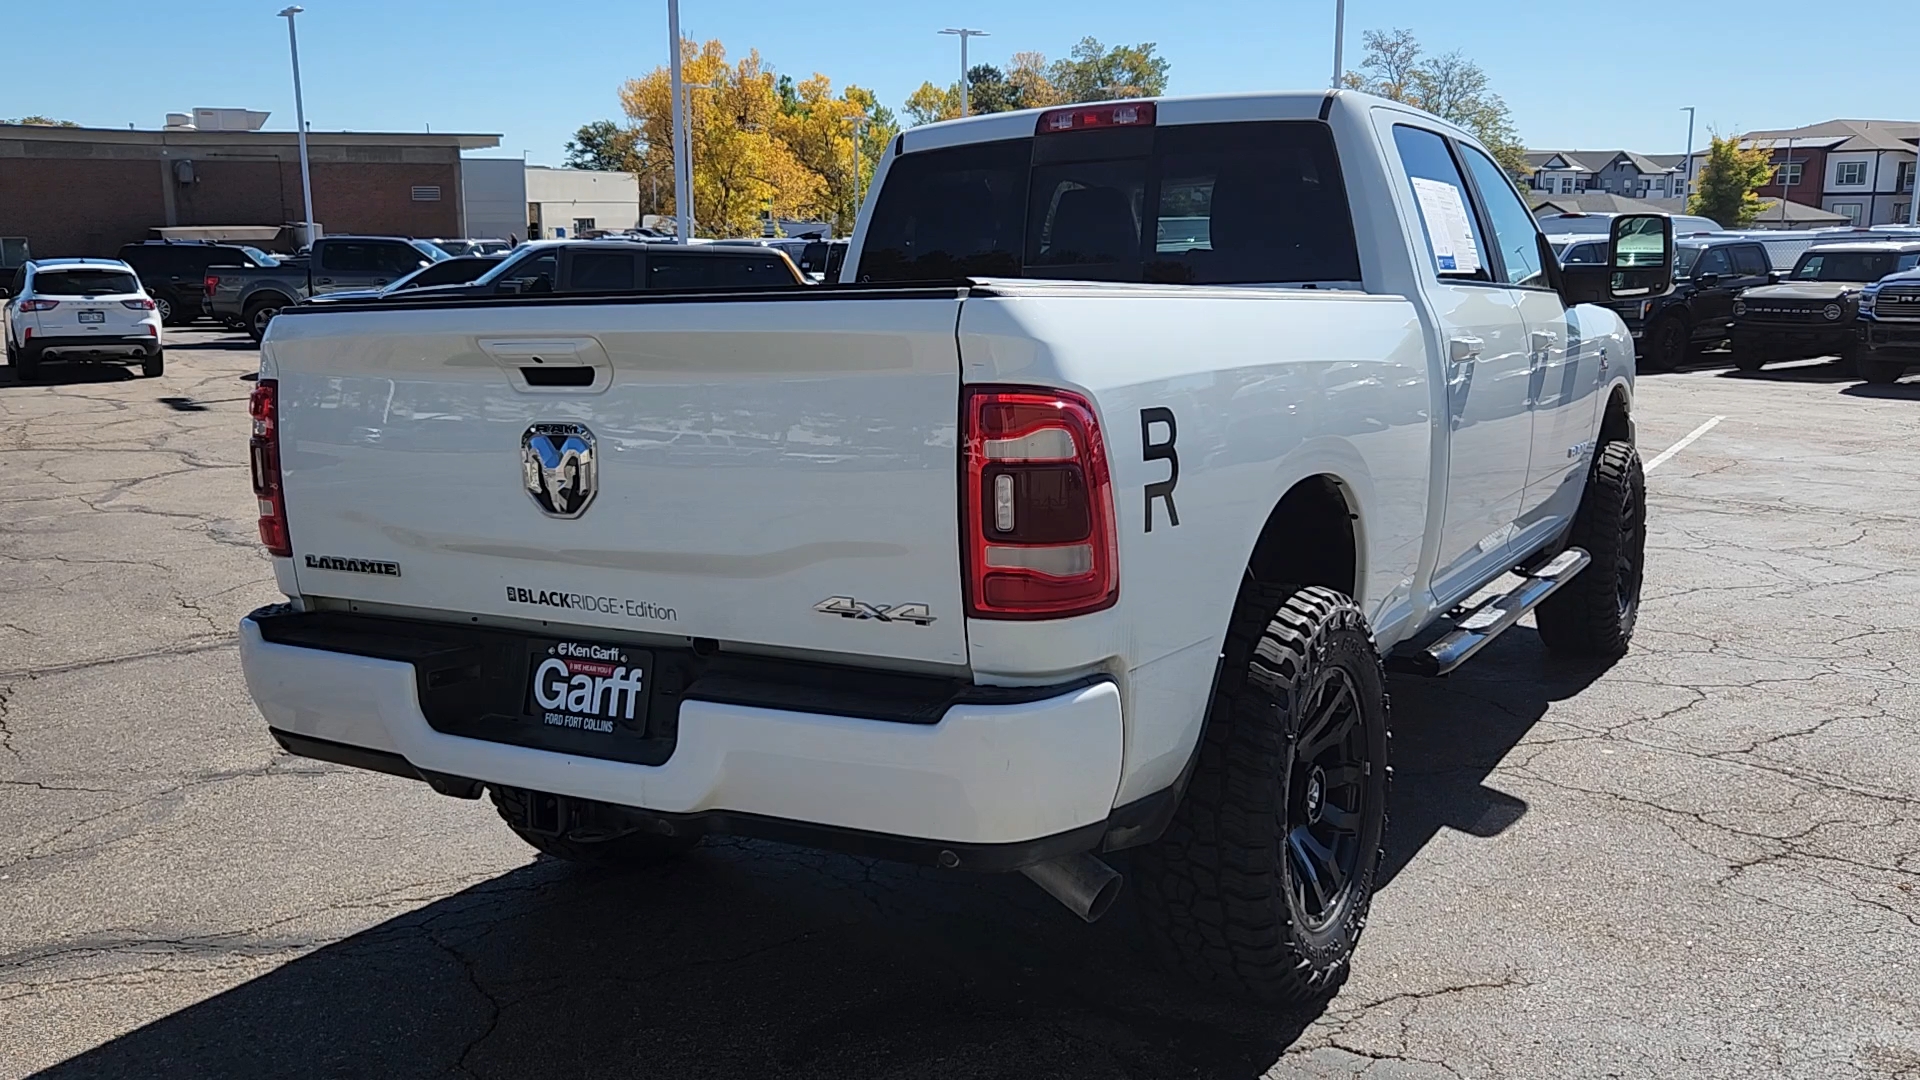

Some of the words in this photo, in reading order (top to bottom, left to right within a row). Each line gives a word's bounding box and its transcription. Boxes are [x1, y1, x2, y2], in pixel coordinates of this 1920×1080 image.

[535, 424, 578, 434] RAM
[304, 554, 400, 576] LARAMIE
[568, 643, 590, 658] Ken
[590, 645, 620, 661] Garff
[573, 663, 582, 671] WE
[582, 664, 597, 672] HEAR
[597, 666, 608, 674] YOU
[534, 658, 643, 719] Garff
[544, 713, 563, 726] FORD
[564, 715, 583, 729] FORT
[583, 717, 614, 733] COLLINS
